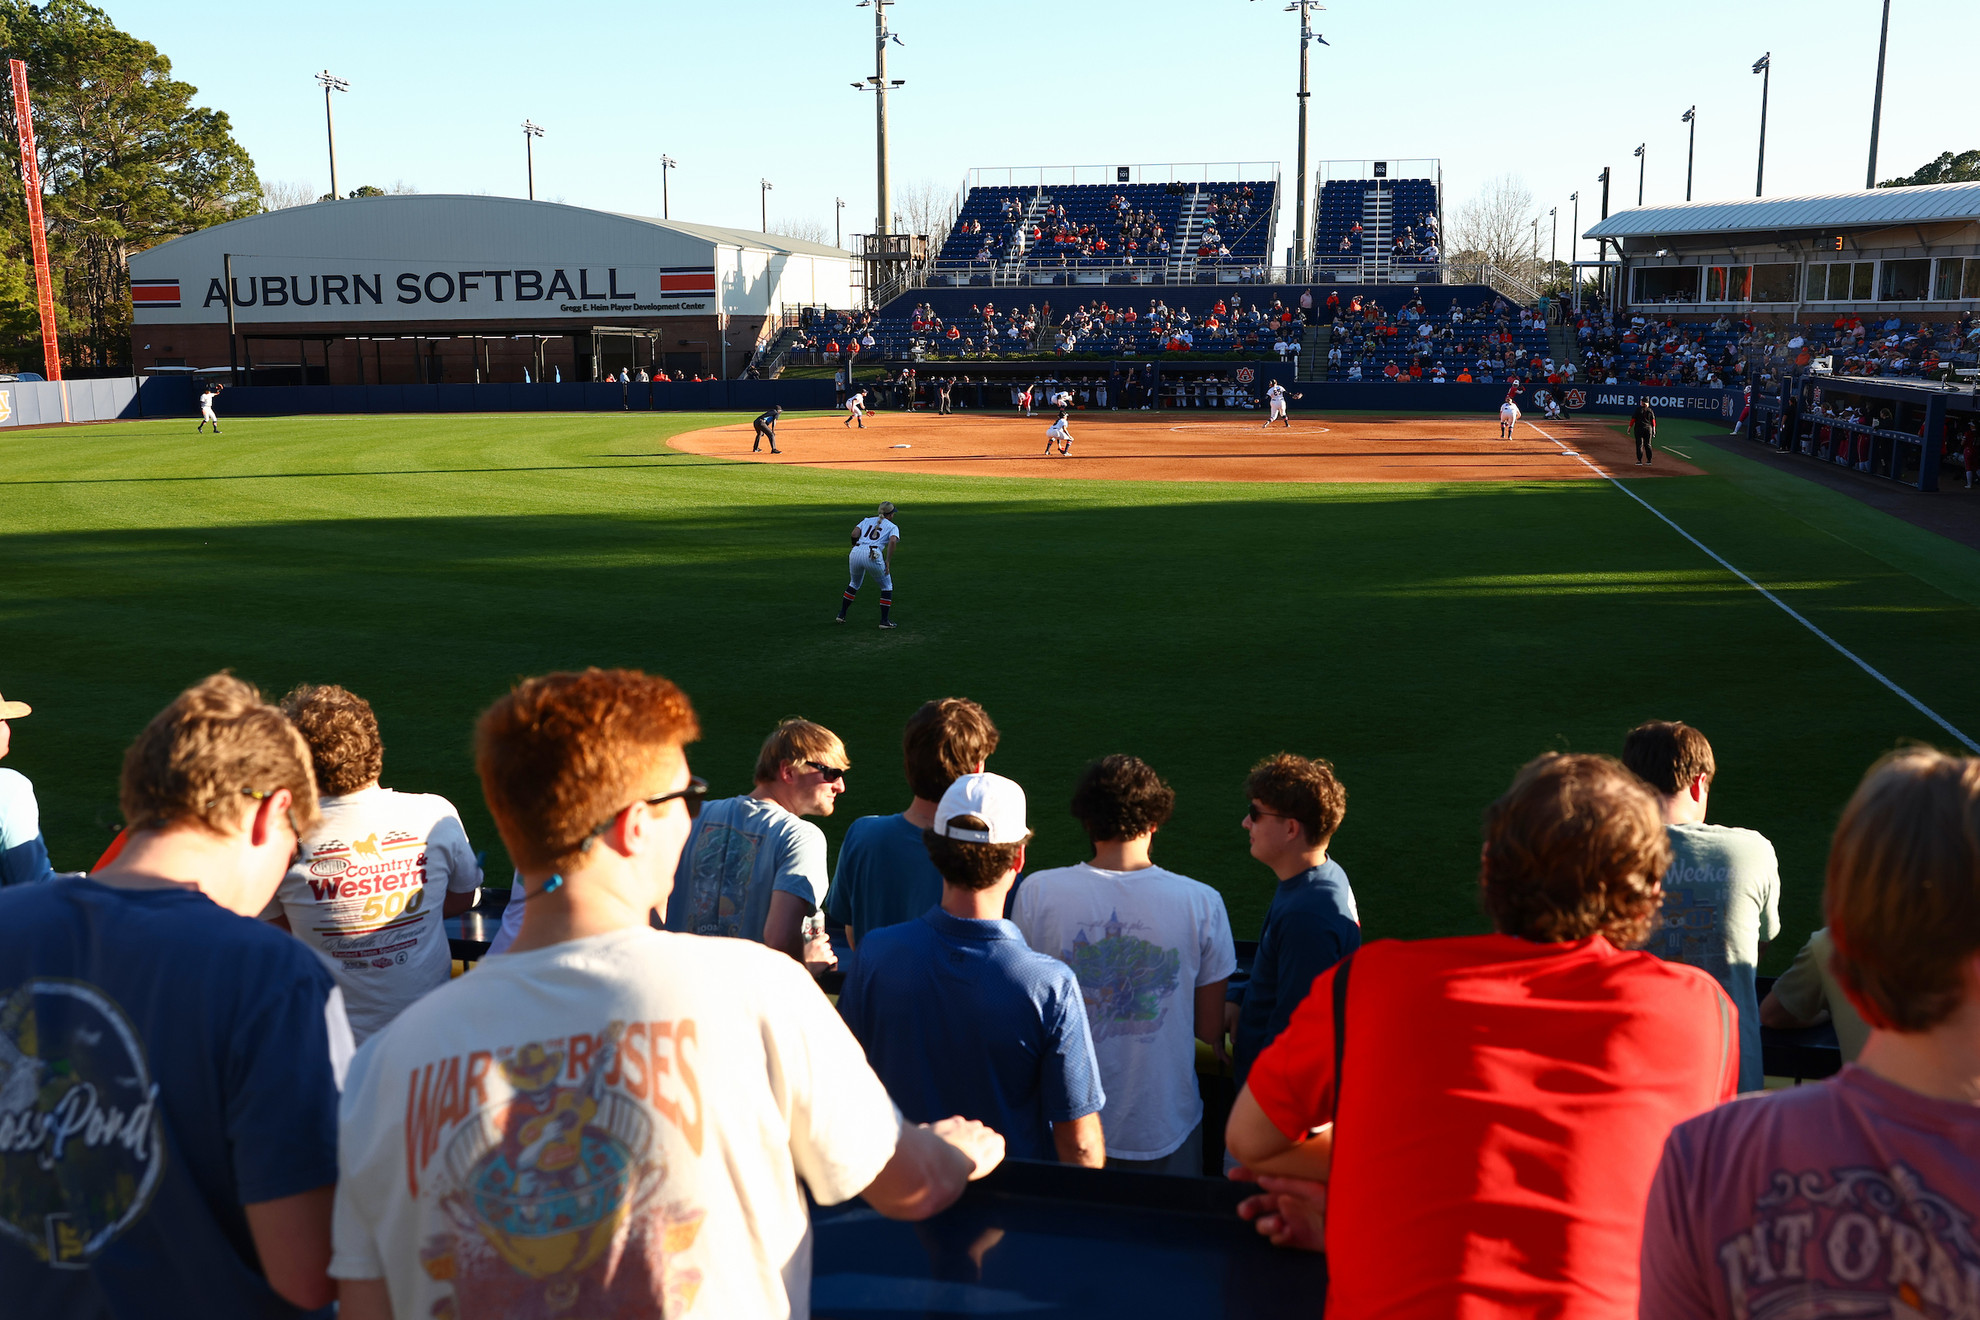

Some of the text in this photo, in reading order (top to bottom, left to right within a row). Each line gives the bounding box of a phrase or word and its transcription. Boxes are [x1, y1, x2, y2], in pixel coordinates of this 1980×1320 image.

[1835, 236, 1843, 250] 3
[203, 268, 636, 308] AUBURN SOFTBALL
[560, 302, 706, 313] Gregg E. Heim Player Development Center
[1595, 394, 1625, 405] JANE
[1627, 394, 1637, 406] B.
[1640, 395, 1684, 408] OORE
[1687, 397, 1720, 410] FIELD
[864, 525, 882, 541] 16
[346, 852, 428, 878] Country &
[308, 869, 428, 901] Western
[361, 887, 425, 922] 500
[405, 1050, 493, 1201] WAR
